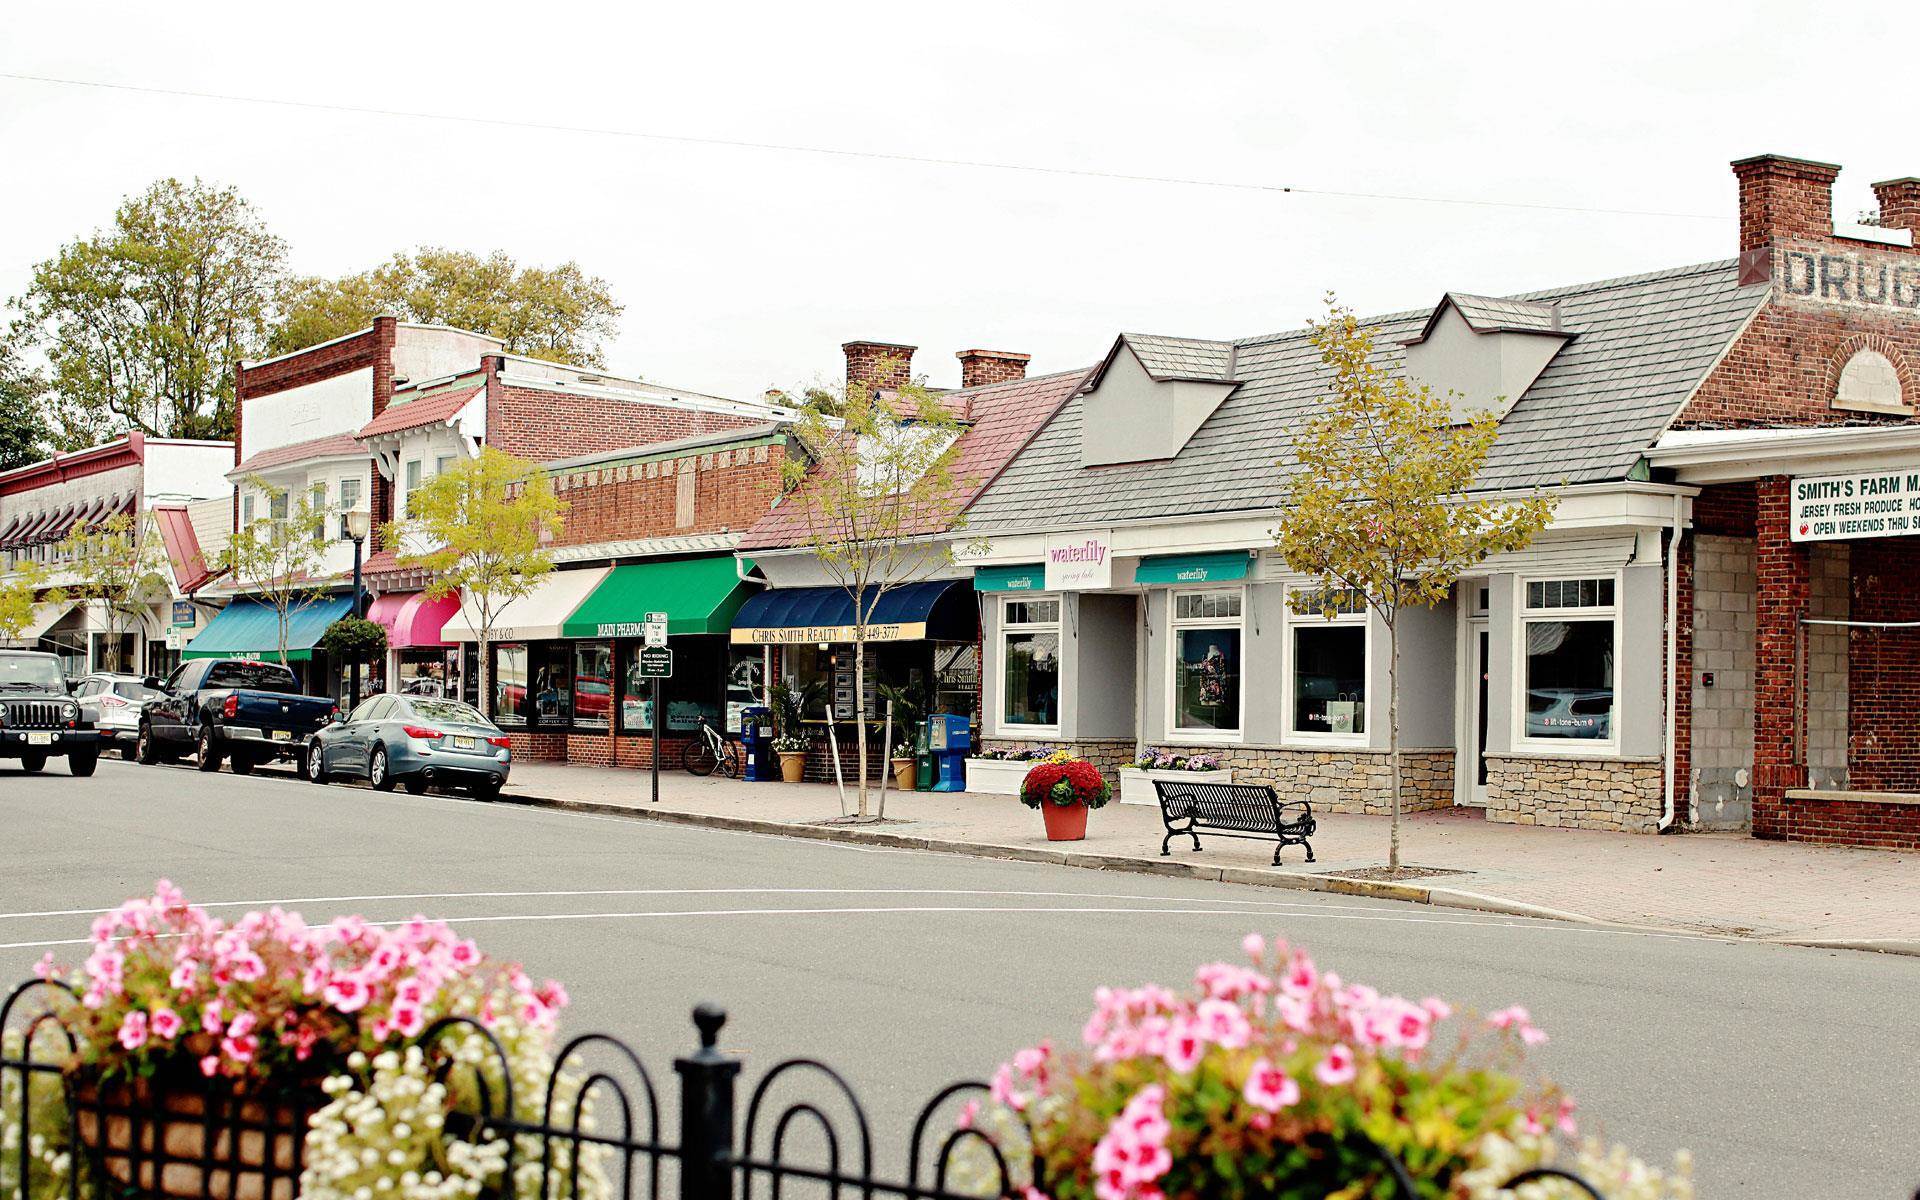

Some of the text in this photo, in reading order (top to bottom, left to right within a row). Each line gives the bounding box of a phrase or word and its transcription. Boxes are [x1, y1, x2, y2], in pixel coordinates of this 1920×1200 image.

[1798, 474, 1920, 500] SMITH'S FARM M
[1800, 504, 1830, 518] JERSEY
[1834, 502, 1860, 516] FRESH
[1864, 499, 1902, 514] PRODUCE
[1814, 522, 1835, 535] OPEN
[1839, 518, 1884, 533] WEEKENDS
[1888, 517, 1908, 530] THRU
[1050, 540, 1106, 565] waterlily
[1176, 567, 1208, 581] waterlily
[1007, 577, 1032, 589] waterlily
[597, 624, 616, 636] MAIN
[752, 627, 839, 642] CHRIS SMITH REALTY
